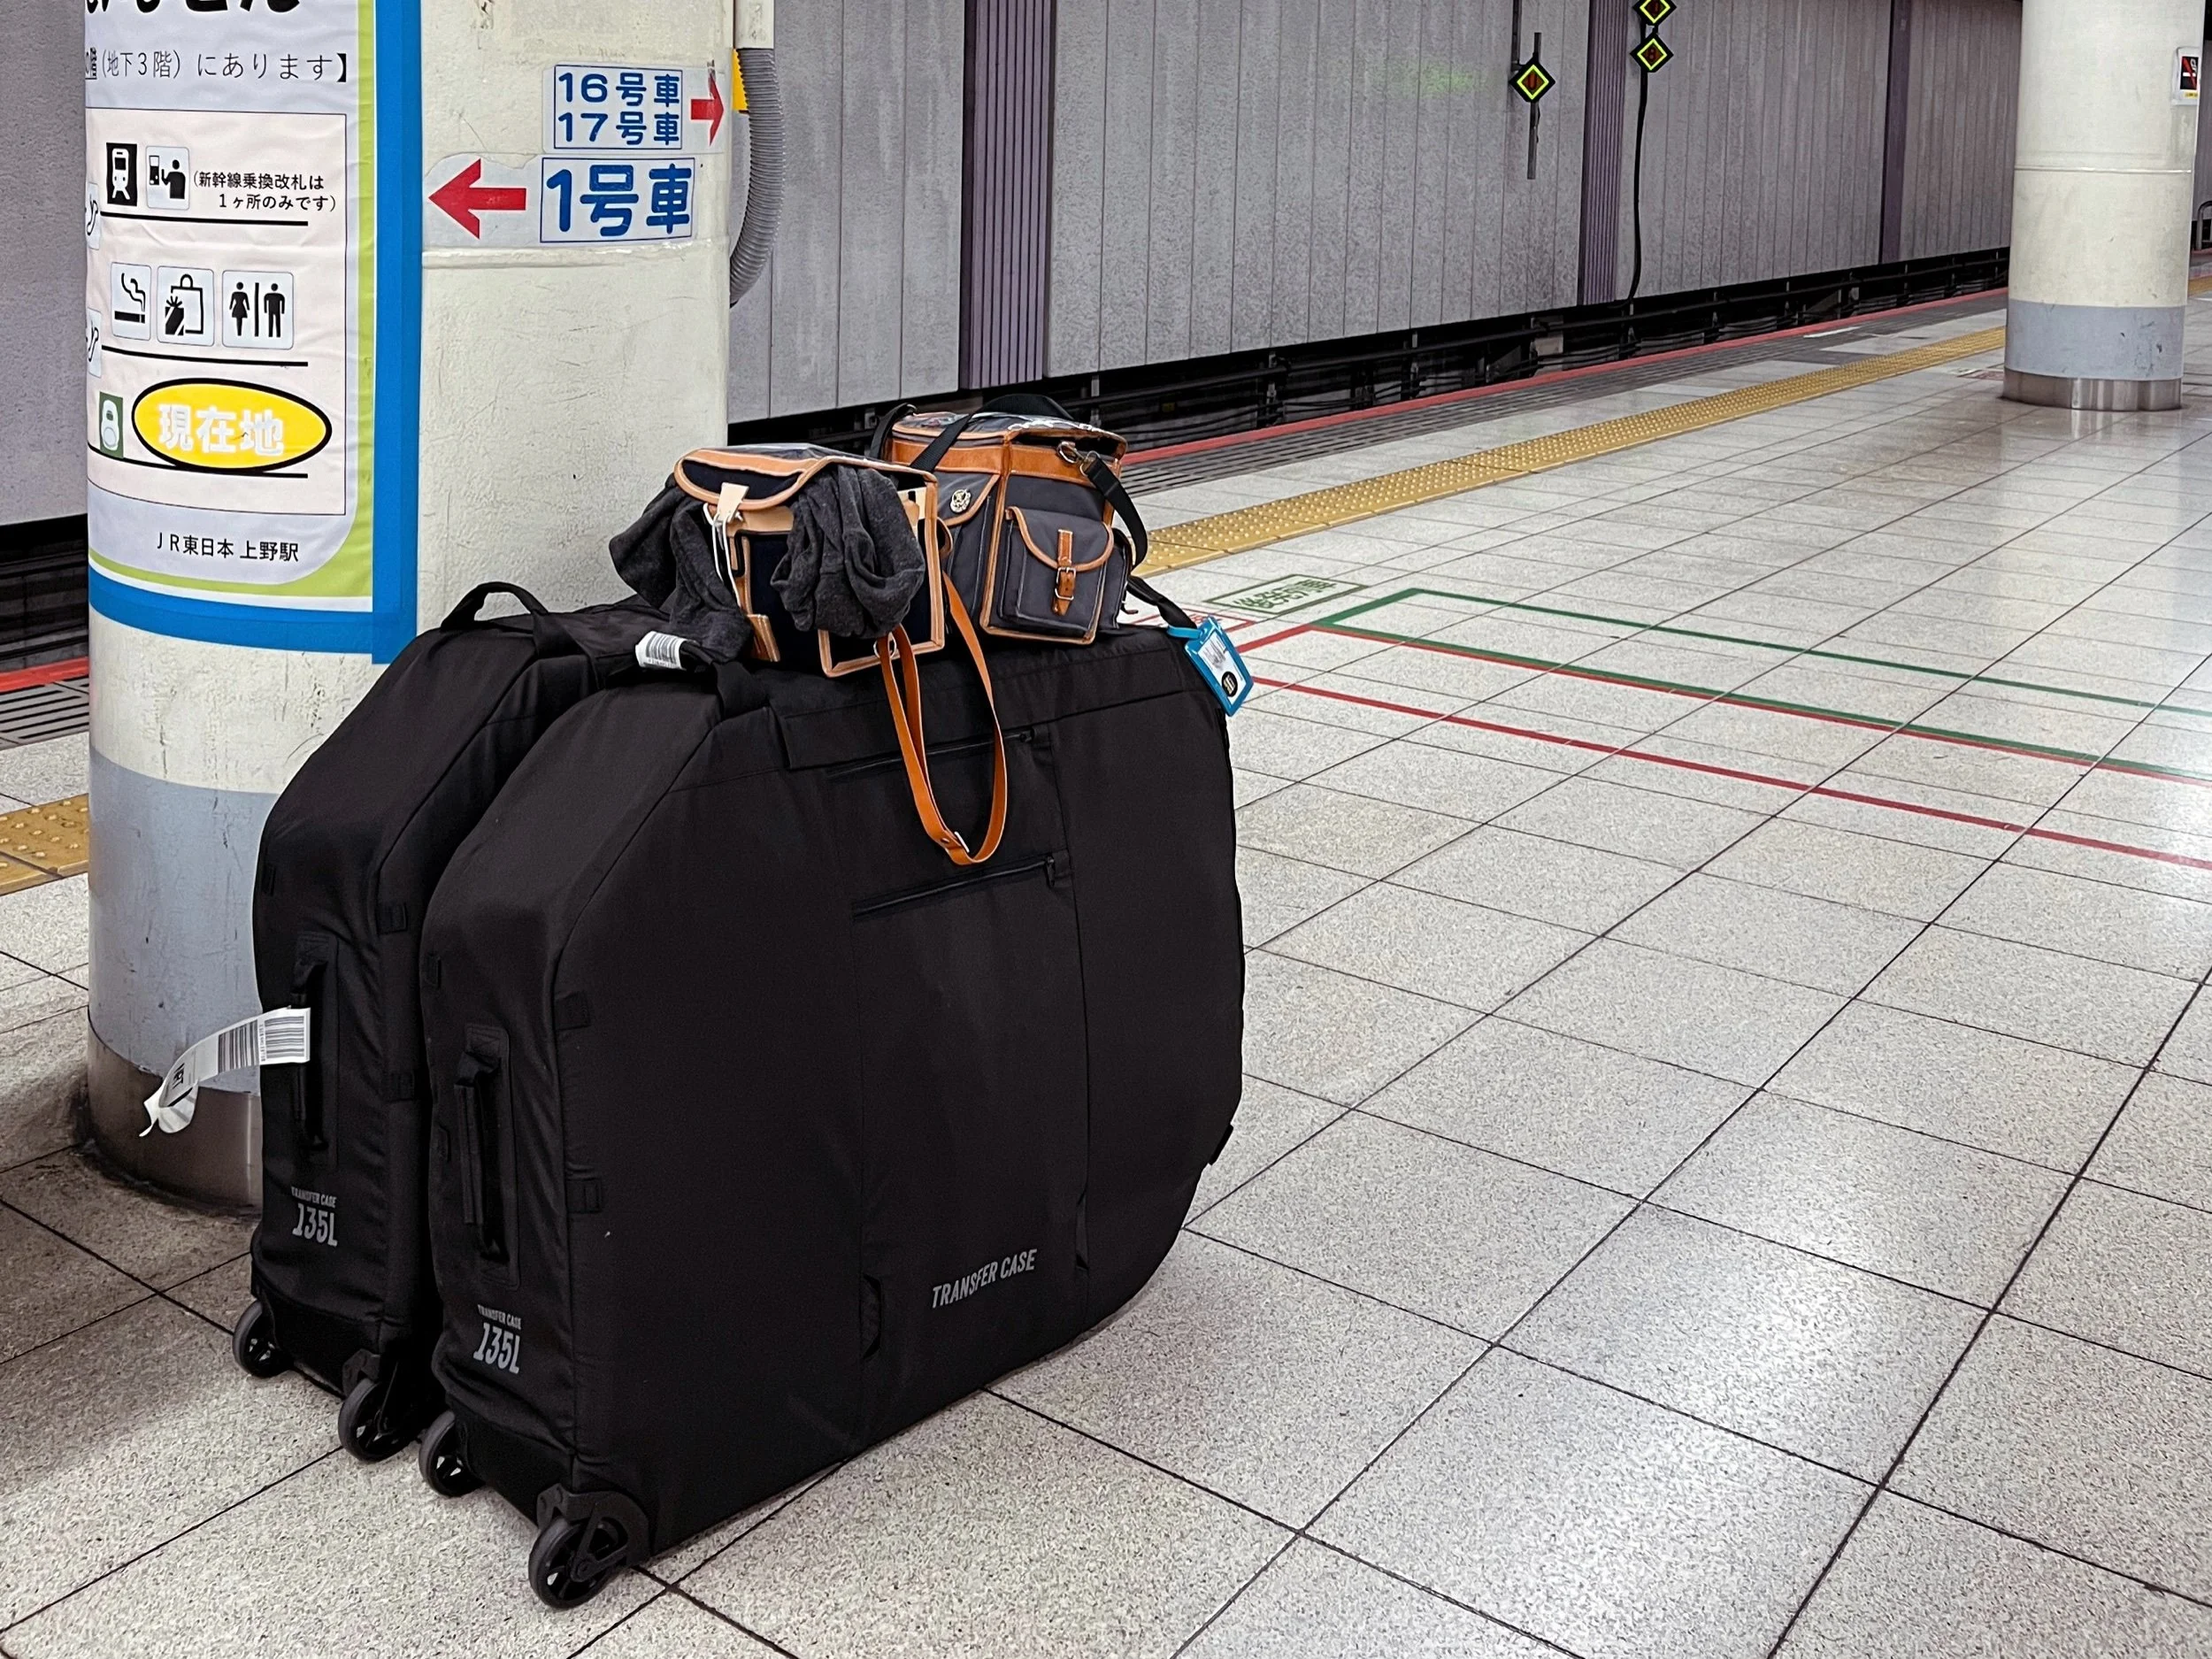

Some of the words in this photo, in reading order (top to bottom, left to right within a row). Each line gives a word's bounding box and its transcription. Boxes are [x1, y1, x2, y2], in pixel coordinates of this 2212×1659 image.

[558, 73, 680, 108] 16号車
[558, 111, 680, 146] 17号車
[546, 164, 692, 237] 1号車
[157, 403, 285, 457] 現在地
[157, 532, 234, 557] JR東日本
[239, 540, 300, 563] 上野駅
[291, 1186, 320, 1205] TRANSFER
[320, 1194, 338, 1209] CASE
[292, 1202, 338, 1248] 135L
[932, 1261, 999, 1309] TRANSFER
[1000, 1248, 1038, 1279] CASE
[477, 1304, 506, 1324] TRANSFER
[506, 1312, 522, 1331] CASE
[472, 1322, 521, 1374] 135L
